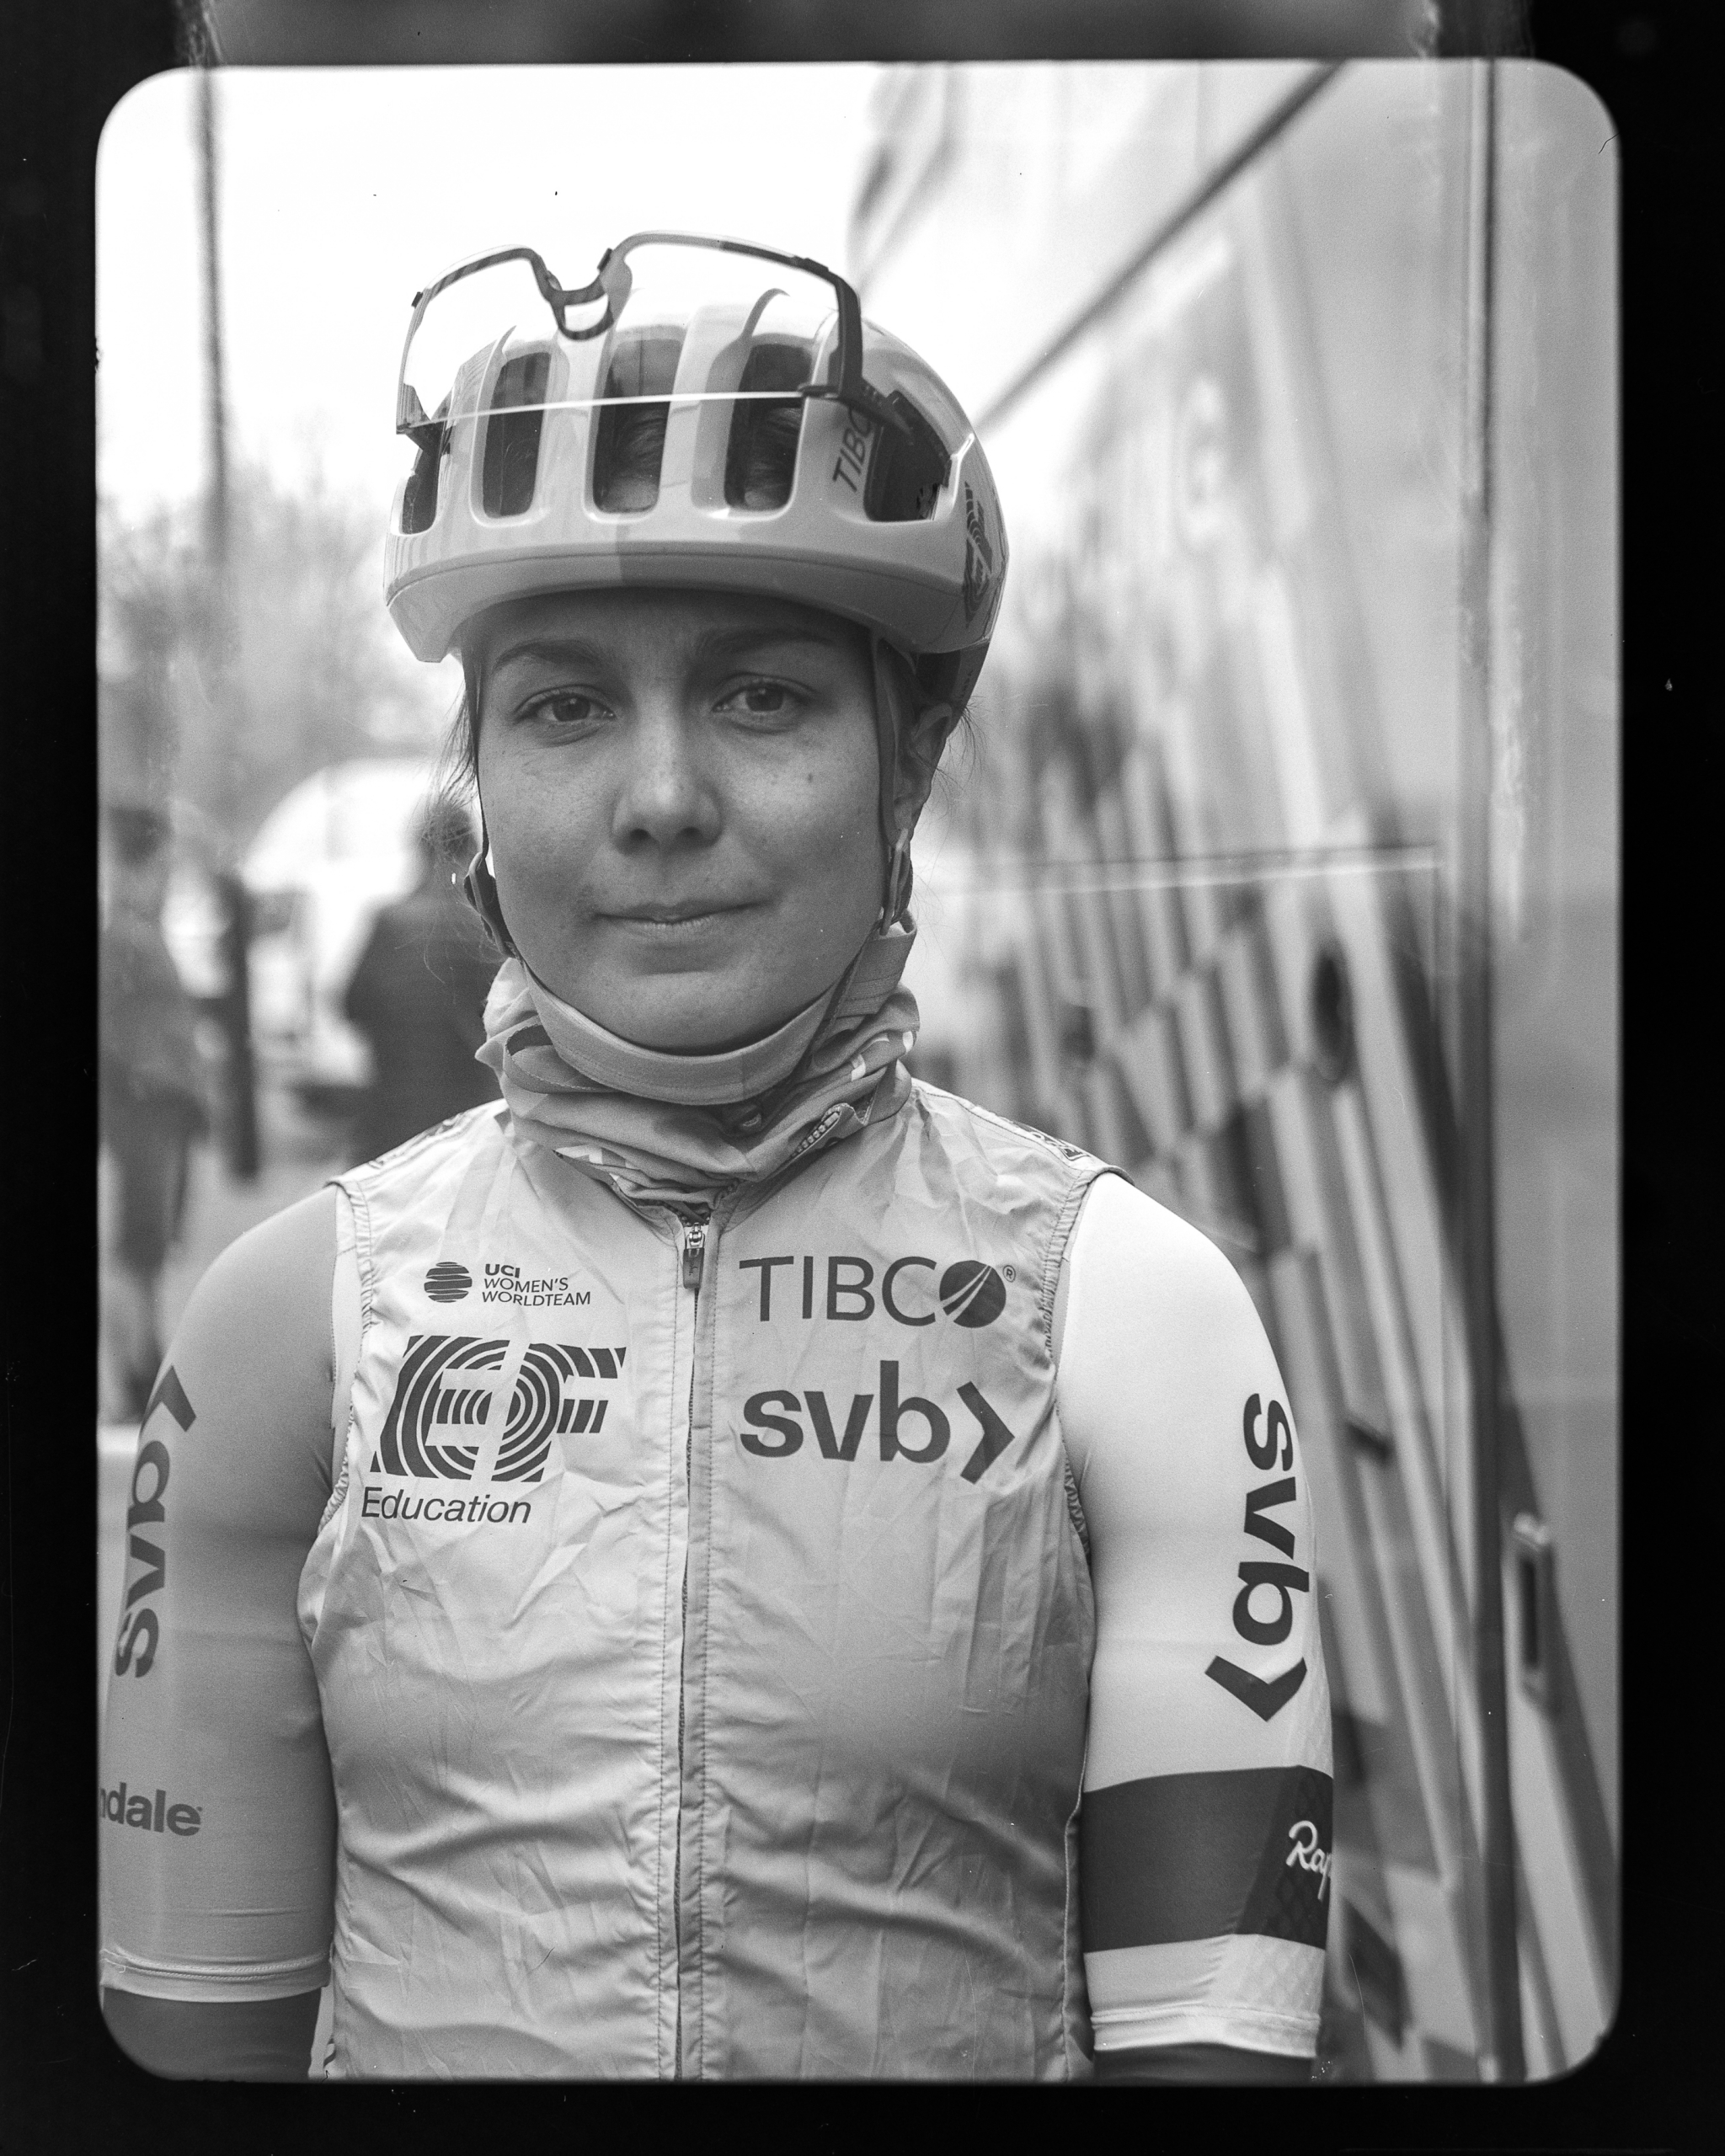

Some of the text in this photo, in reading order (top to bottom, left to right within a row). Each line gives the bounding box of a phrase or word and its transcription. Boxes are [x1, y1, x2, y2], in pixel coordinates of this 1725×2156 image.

[831, 406, 872, 492] TIBC
[484, 1263, 521, 1278] UCI
[483, 1277, 569, 1293] WOMEN'S
[482, 1290, 591, 1306] WORLDTEAM
[360, 1486, 532, 1524] Education
